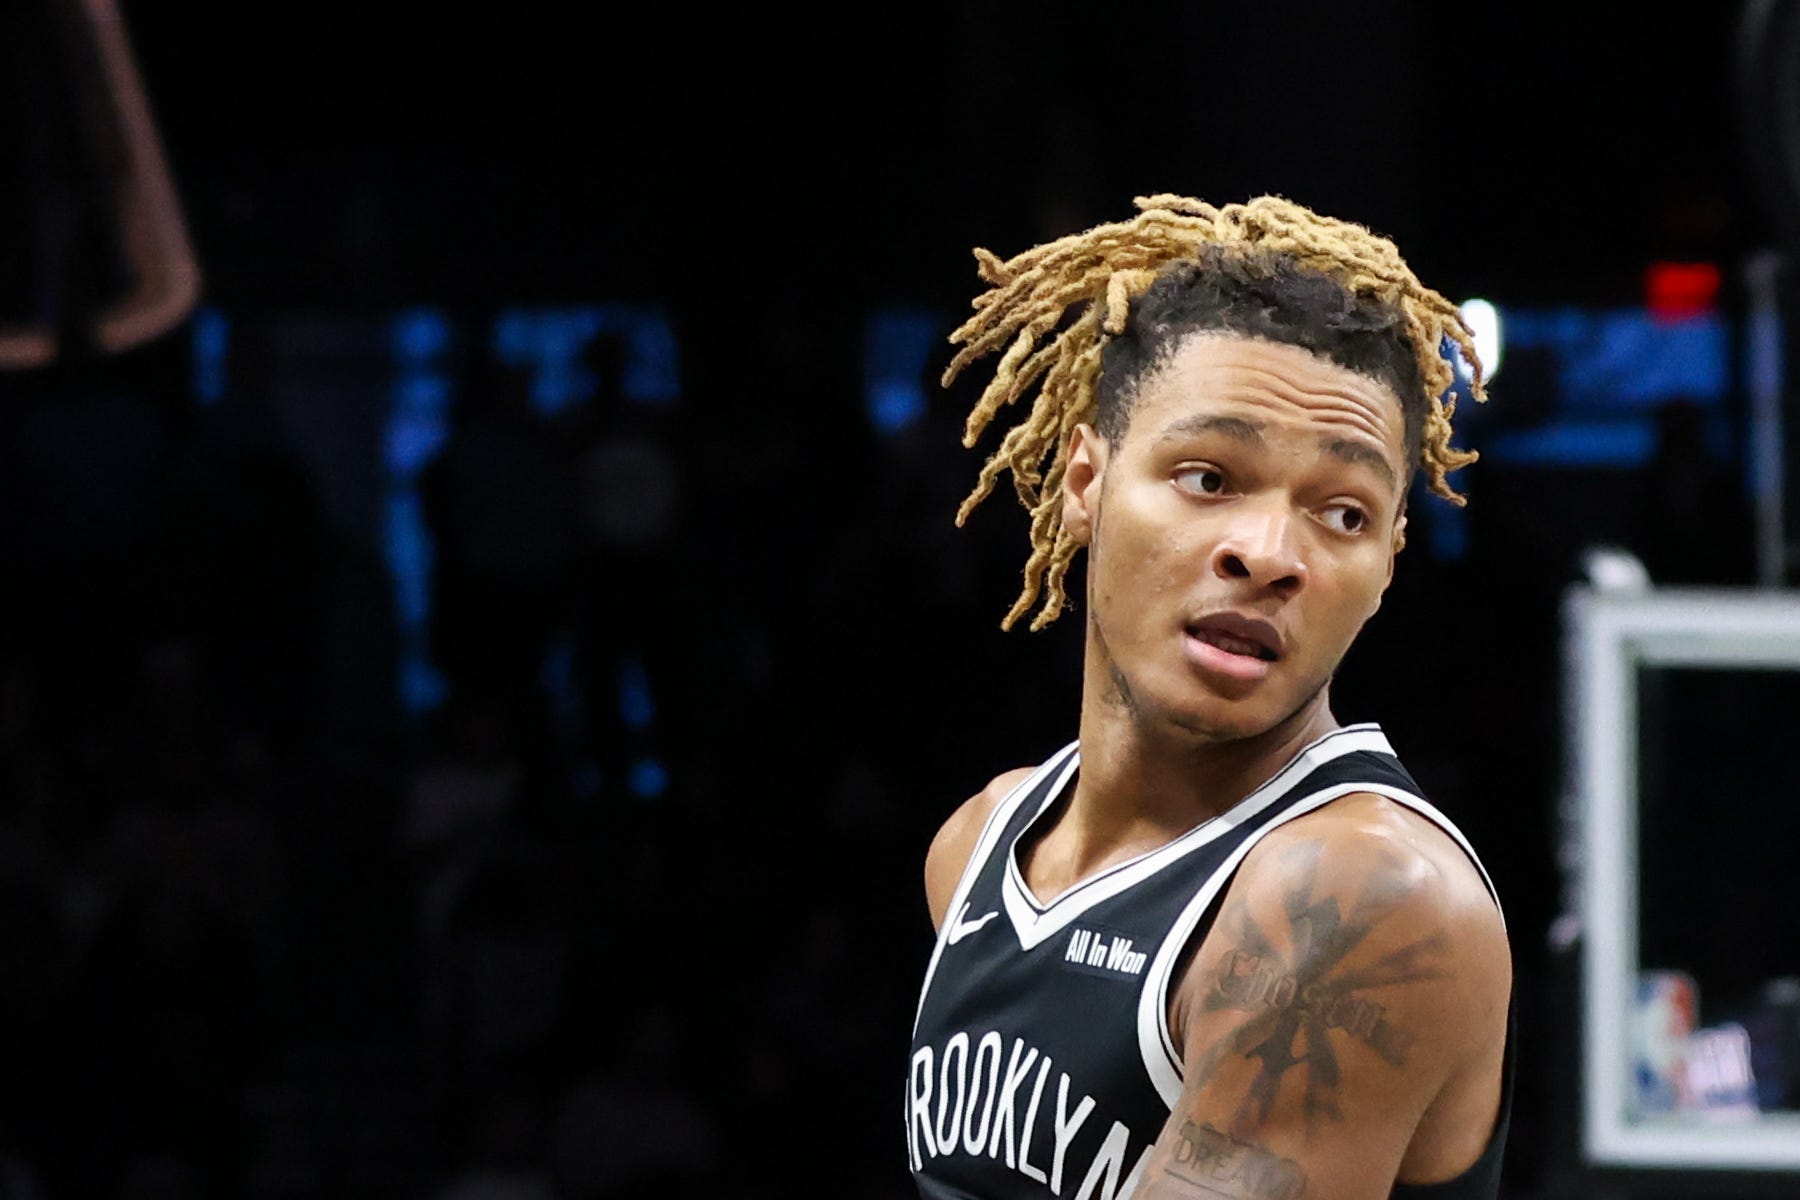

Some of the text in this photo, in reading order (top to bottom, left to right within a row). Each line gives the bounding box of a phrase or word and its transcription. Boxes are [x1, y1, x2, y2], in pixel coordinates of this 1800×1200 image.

[1065, 929, 1147, 975] All In Won
